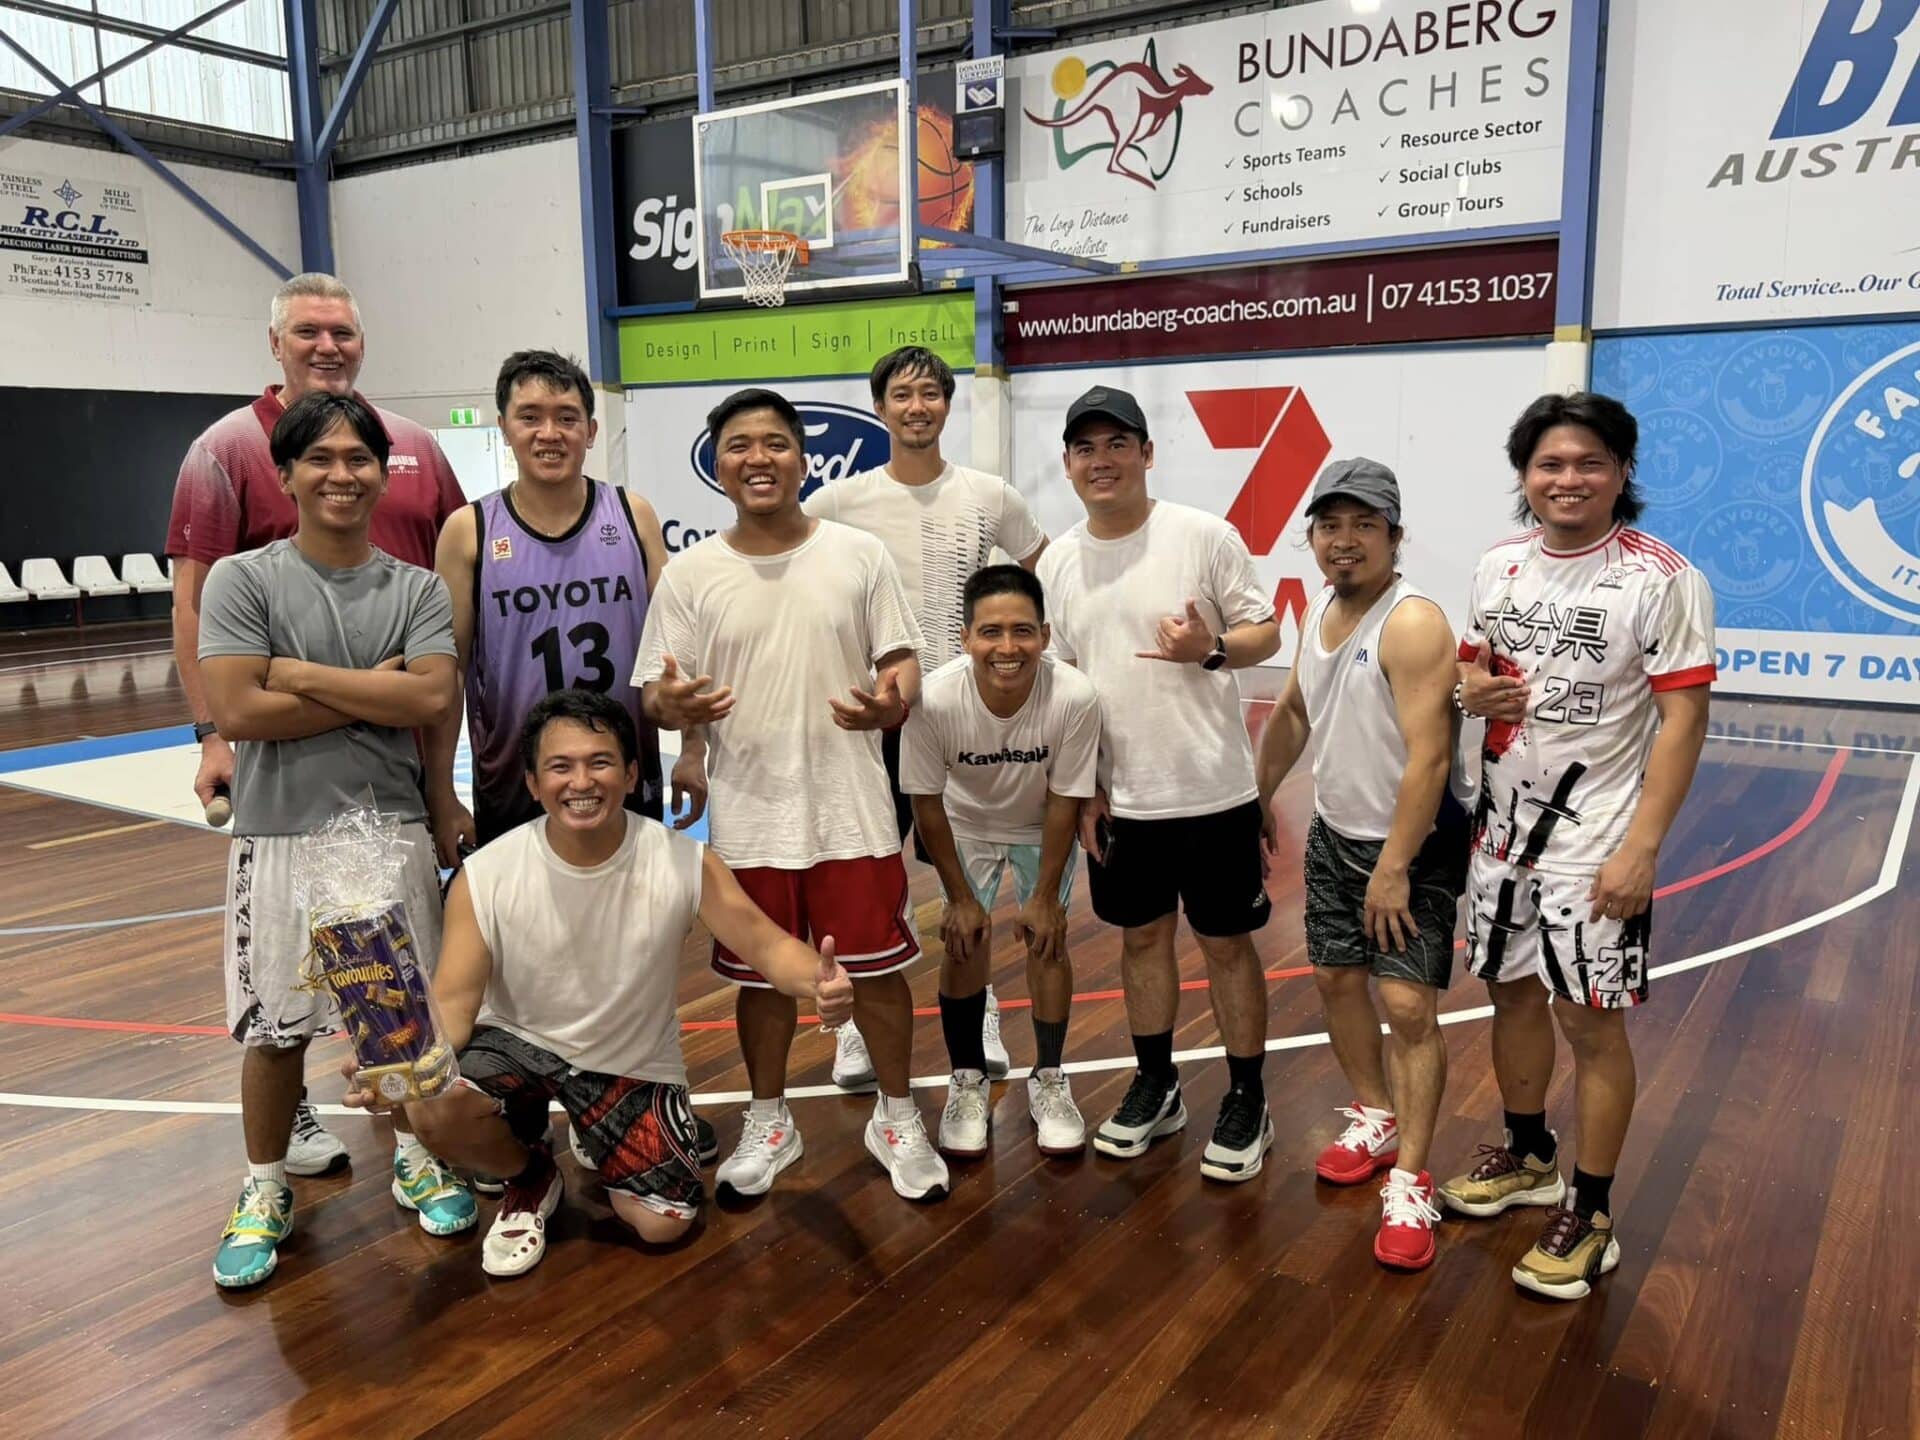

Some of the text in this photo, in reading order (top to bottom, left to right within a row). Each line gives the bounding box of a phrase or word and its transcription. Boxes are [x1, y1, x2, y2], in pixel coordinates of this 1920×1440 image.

[1238, 0, 1556, 83] BUNDABERG
[1234, 57, 1550, 137] COACHES
[1400, 120, 1543, 150] Resource Sector
[1243, 144, 1346, 172] Sports Teams
[1399, 158, 1502, 184] Social Clubs
[103, 196, 133, 207] STEEL
[104, 188, 130, 198] MILD
[1243, 181, 1304, 202] Schools
[20, 205, 119, 236] R.C.L.
[1398, 195, 1504, 218] Group Tours
[1, 225, 140, 248] RUM CITY LASER PTY LTD
[1024, 209, 1129, 237] The Long Distance
[1242, 213, 1331, 235] Fundraisers
[54, 265, 91, 281] 4153
[97, 269, 134, 285] 5778
[1716, 277, 1764, 301] Total
[95, 283, 140, 296] Bundaberg
[1018, 272, 1553, 338] www.bundaberg-coaches.com.au 07 4153 1037
[646, 323, 956, 360] Design Print Sign Install
[1854, 369, 1920, 439] FA
[492, 575, 632, 617] TOYOTA
[531, 621, 615, 696] 13
[1824, 654, 1846, 678] 7
[1535, 676, 1605, 725] 23
[1597, 946, 1645, 993] 23
